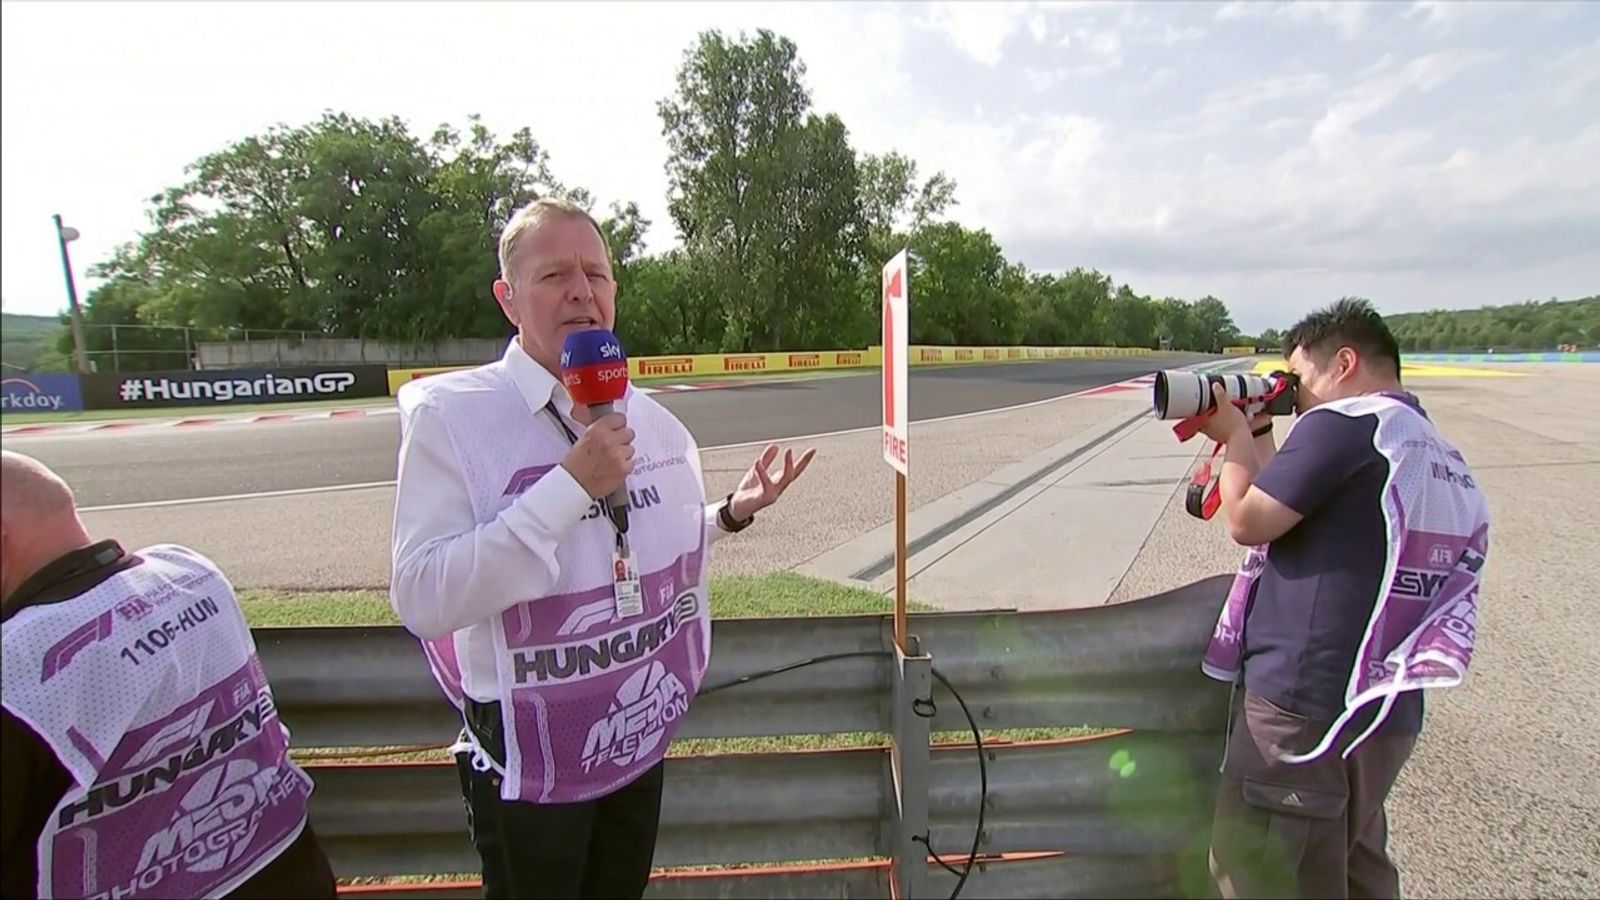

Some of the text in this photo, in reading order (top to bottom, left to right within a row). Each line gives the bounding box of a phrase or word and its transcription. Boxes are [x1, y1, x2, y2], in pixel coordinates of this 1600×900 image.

[600, 342, 621, 360] sky
[639, 358, 693, 375] PIRELLI
[724, 356, 766, 371] PIRELLI
[789, 354, 819, 367] PIRELLI
[598, 366, 628, 384] sport
[120, 373, 355, 401] #HungarianGP
[2, 393, 61, 410] rkday
[884, 431, 906, 464] FIRE
[119, 598, 150, 621] FIA
[120, 596, 220, 666] 1106-HUN
[581, 672, 687, 760] MEDIA
